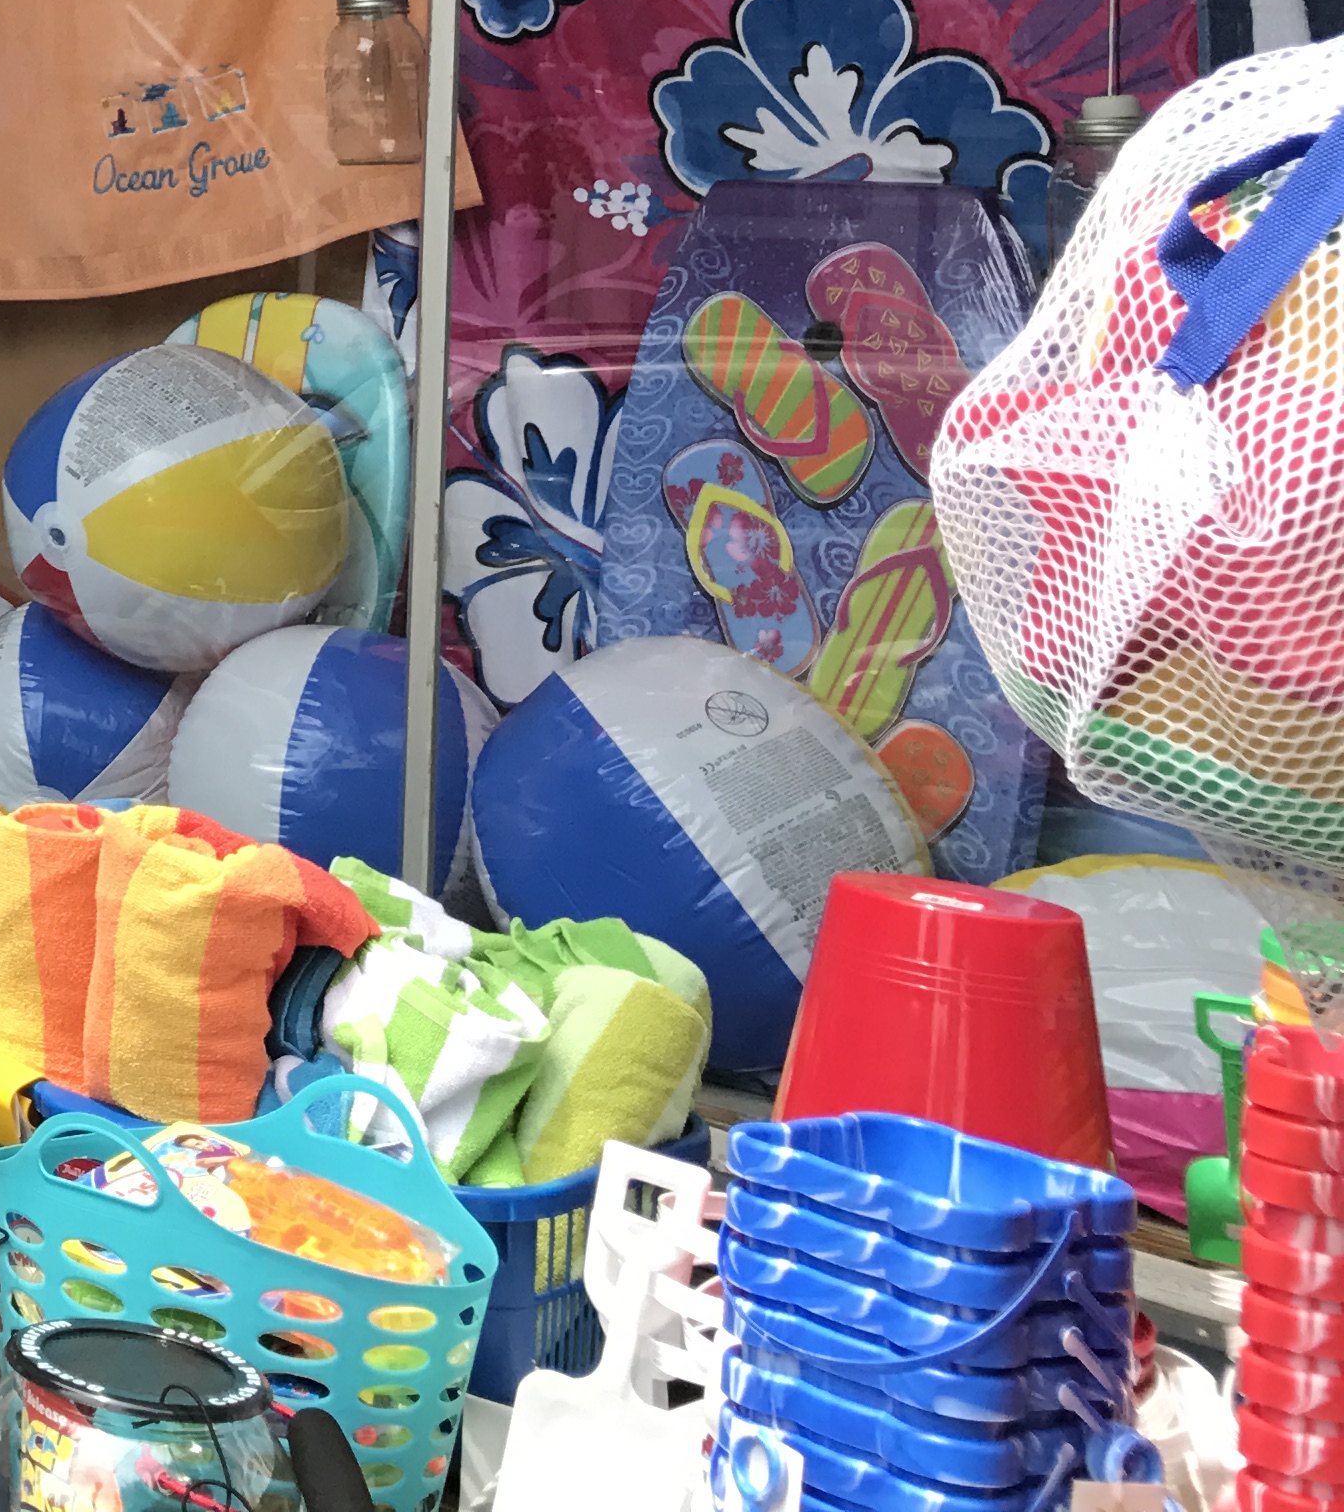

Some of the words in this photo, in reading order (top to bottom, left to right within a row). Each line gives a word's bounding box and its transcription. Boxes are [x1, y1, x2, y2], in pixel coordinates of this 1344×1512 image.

[93, 153, 179, 194] Ocean
[189, 141, 270, 198] Grove
[21, 1320, 72, 1360] Aquarium
[162, 1328, 247, 1365] Release
[37, 1361, 105, 1392] Beach
[208, 1385, 259, 1407] Catch
